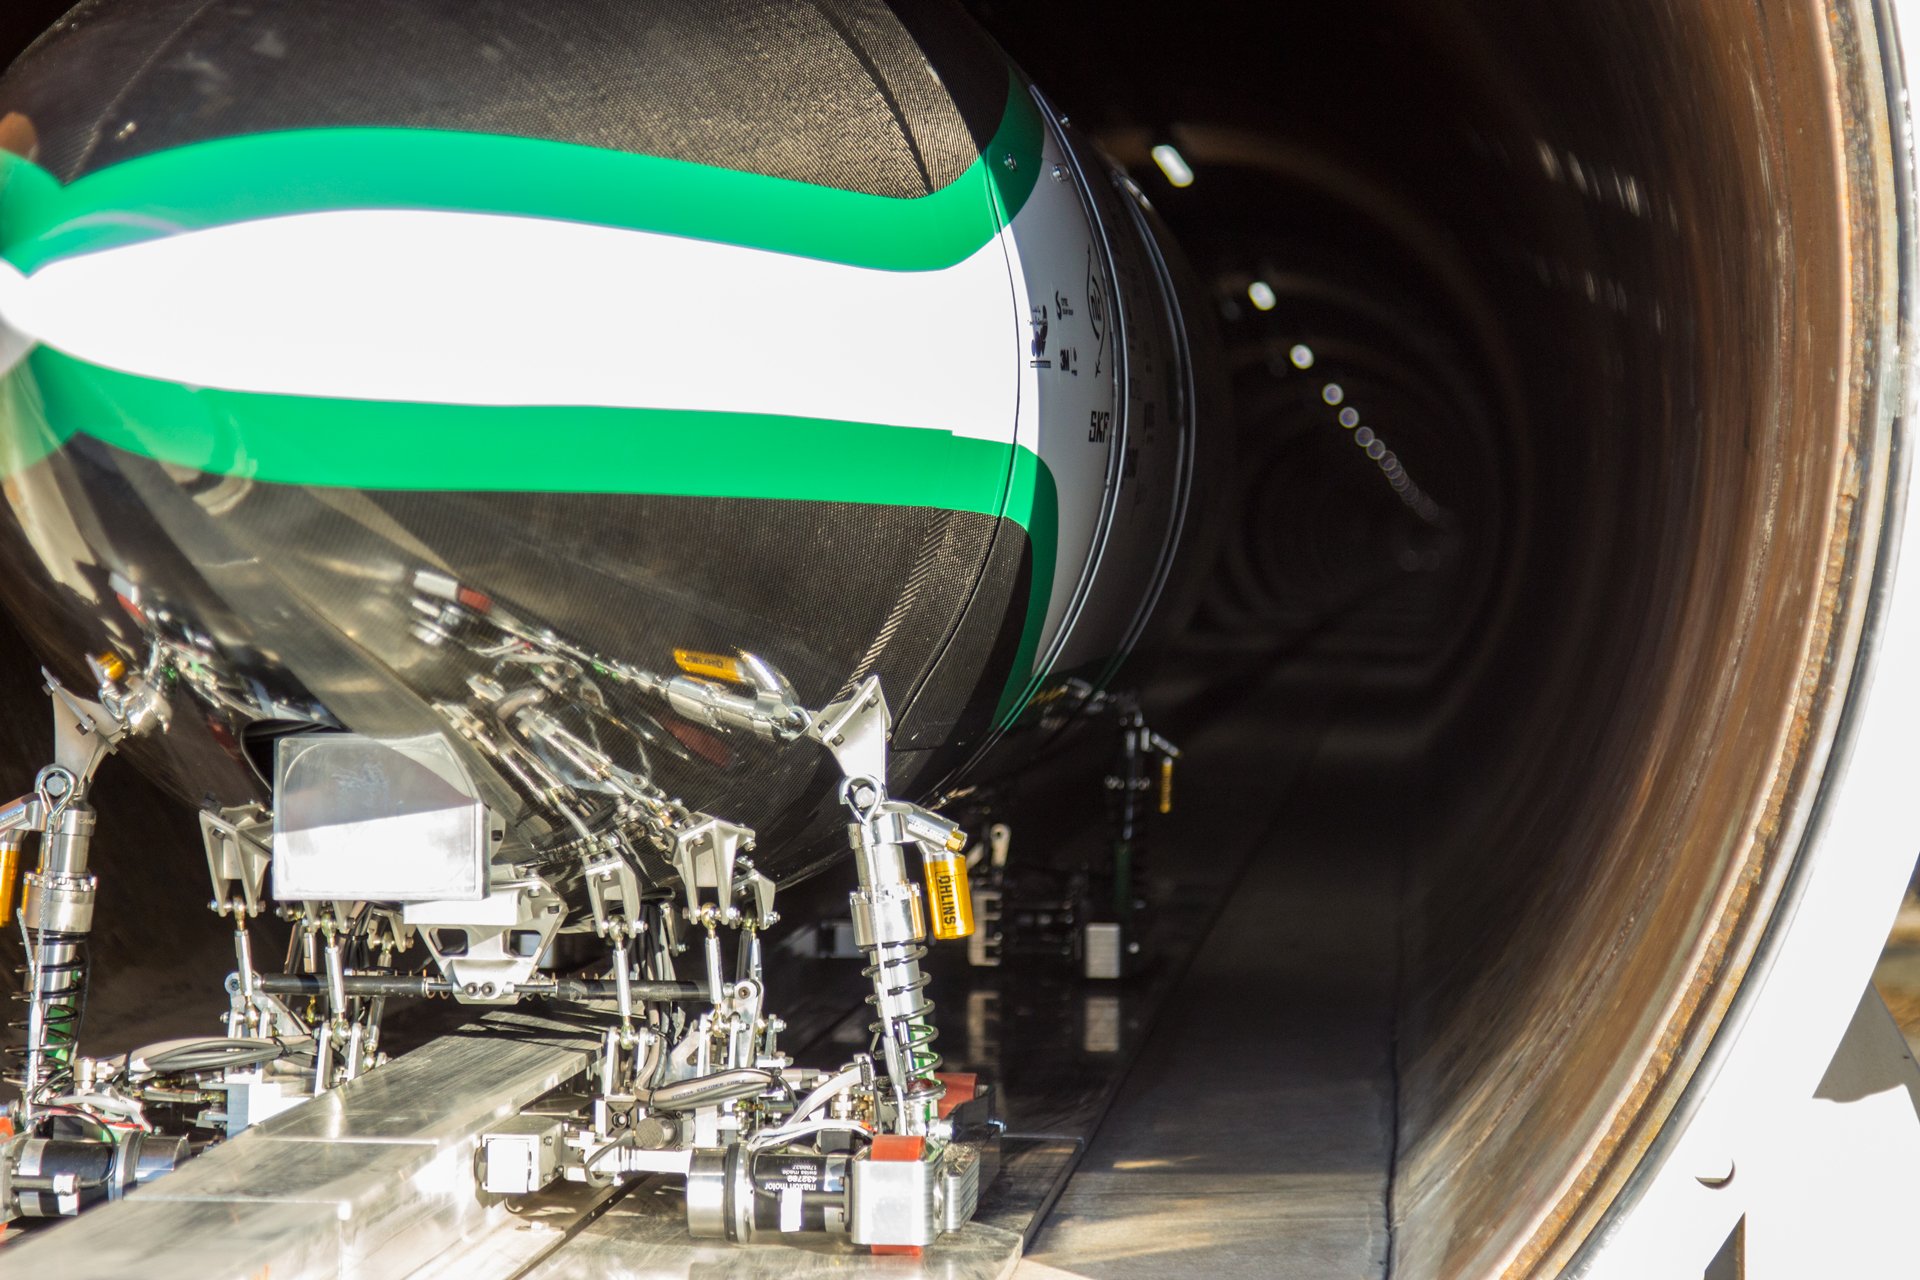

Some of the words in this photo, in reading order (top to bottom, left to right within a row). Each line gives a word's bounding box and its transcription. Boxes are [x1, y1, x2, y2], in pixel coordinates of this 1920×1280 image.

[1088, 410, 1110, 443] SKF
[764, 1182, 788, 1191] motor
[789, 1183, 817, 1191] maxon
